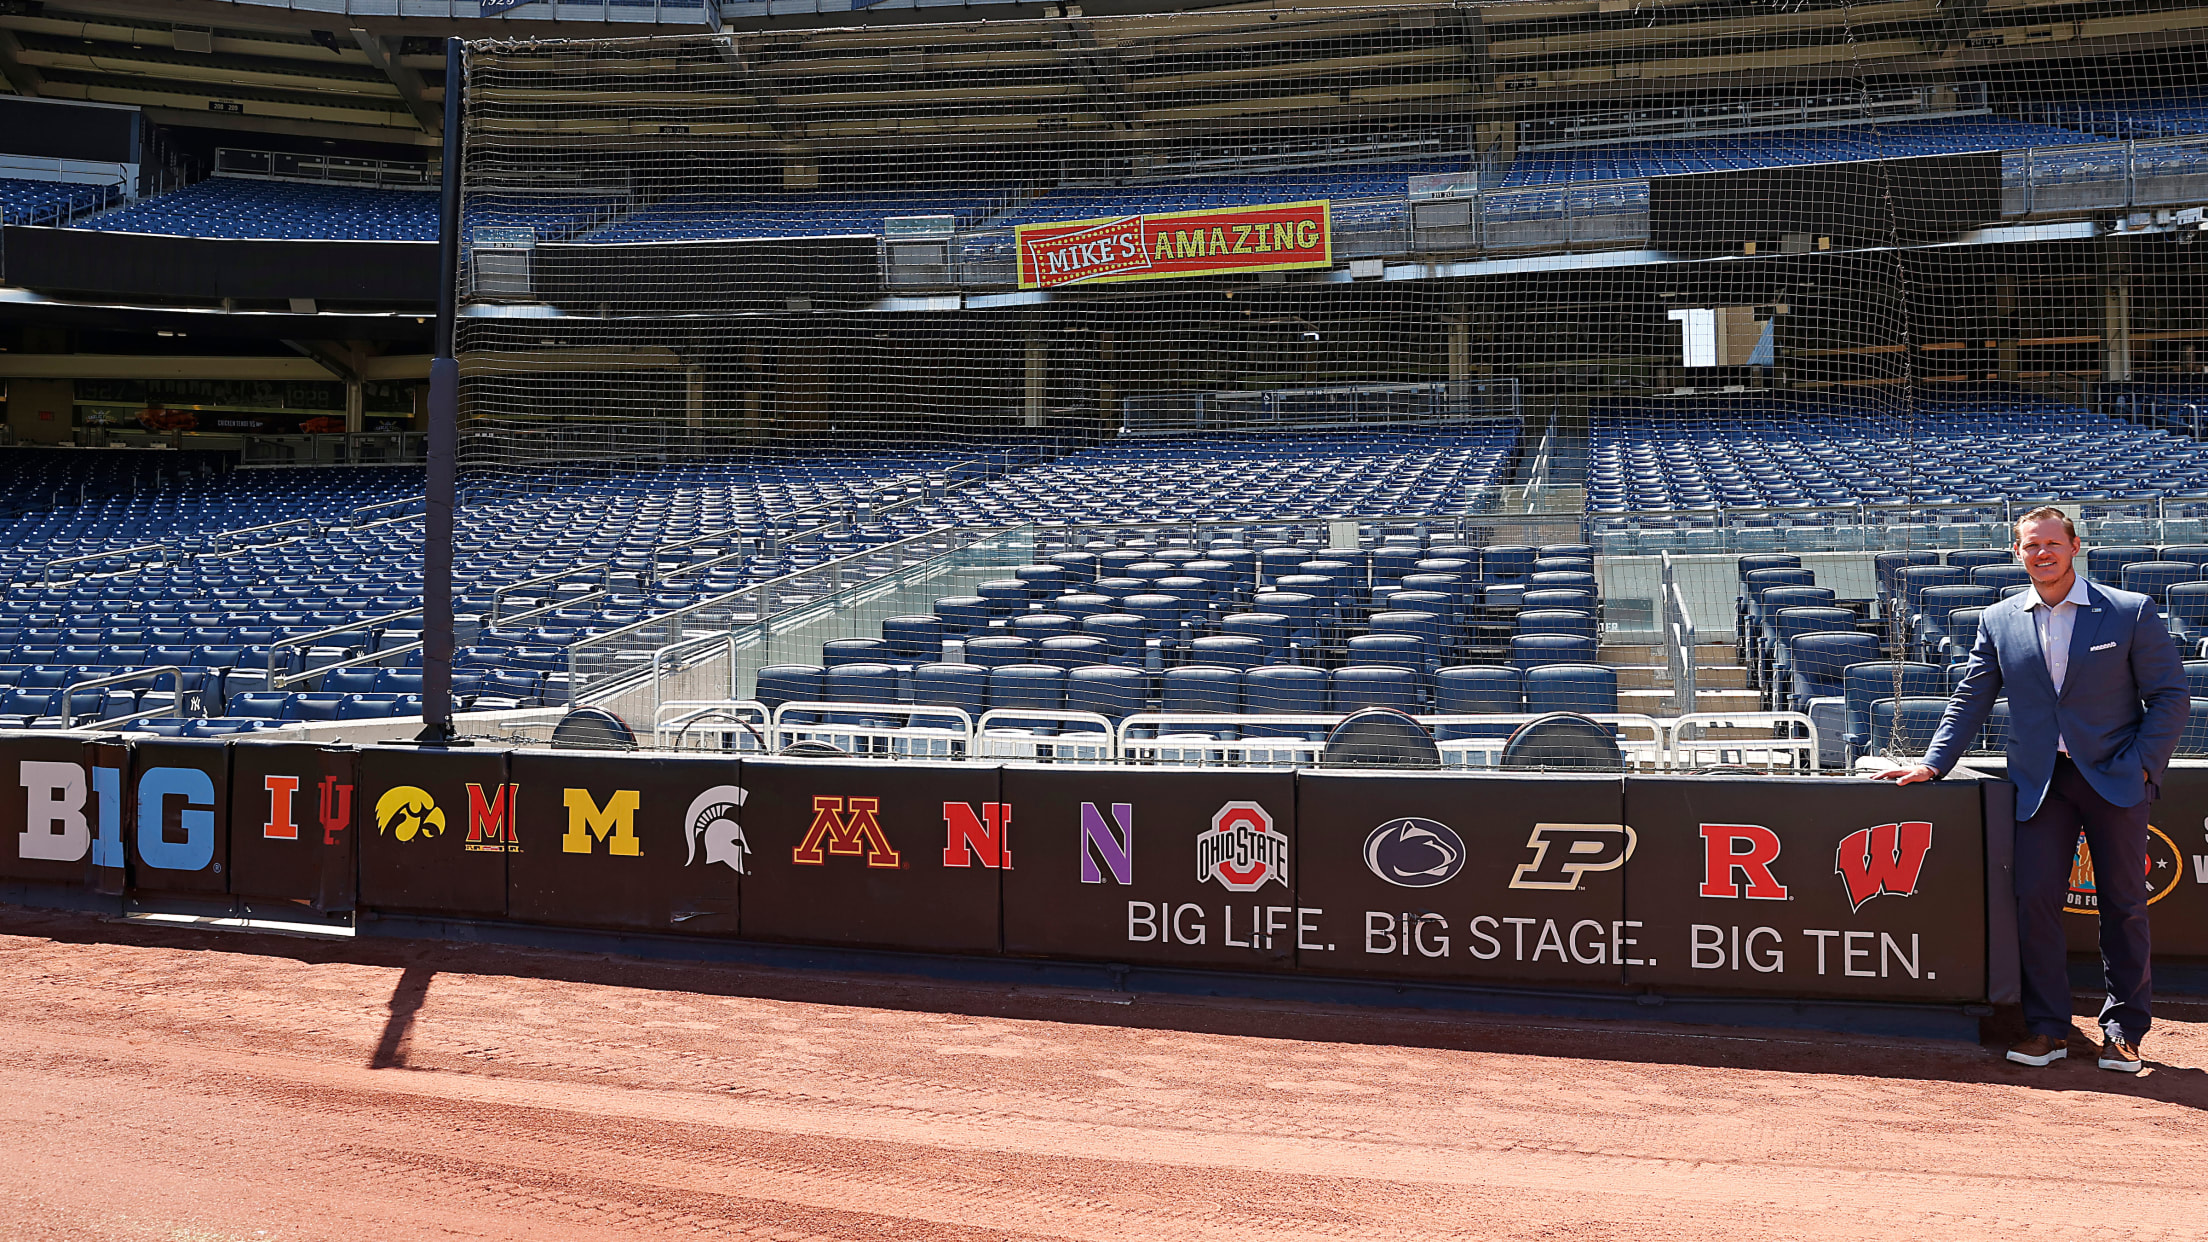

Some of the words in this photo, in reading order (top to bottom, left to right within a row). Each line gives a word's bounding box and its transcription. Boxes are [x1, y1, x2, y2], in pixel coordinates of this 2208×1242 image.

[1047, 233, 1136, 274] MIKE'S
[1154, 219, 1320, 259] AMAZING
[264, 775, 299, 840] I
[465, 783, 520, 843] M
[562, 788, 640, 856] M
[792, 795, 900, 869] M
[943, 802, 1012, 869] N
[1081, 802, 1132, 885] N
[1508, 823, 1638, 891] P
[1700, 823, 1788, 900] R
[1835, 821, 1933, 915] W
[1128, 900, 1206, 945] BIG
[1225, 905, 1335, 951] LIFE.
[1365, 911, 1450, 957] BIG
[1468, 915, 1657, 966] STAGE.
[1691, 924, 1784, 973] BIG
[1803, 929, 1936, 980] TEN.
